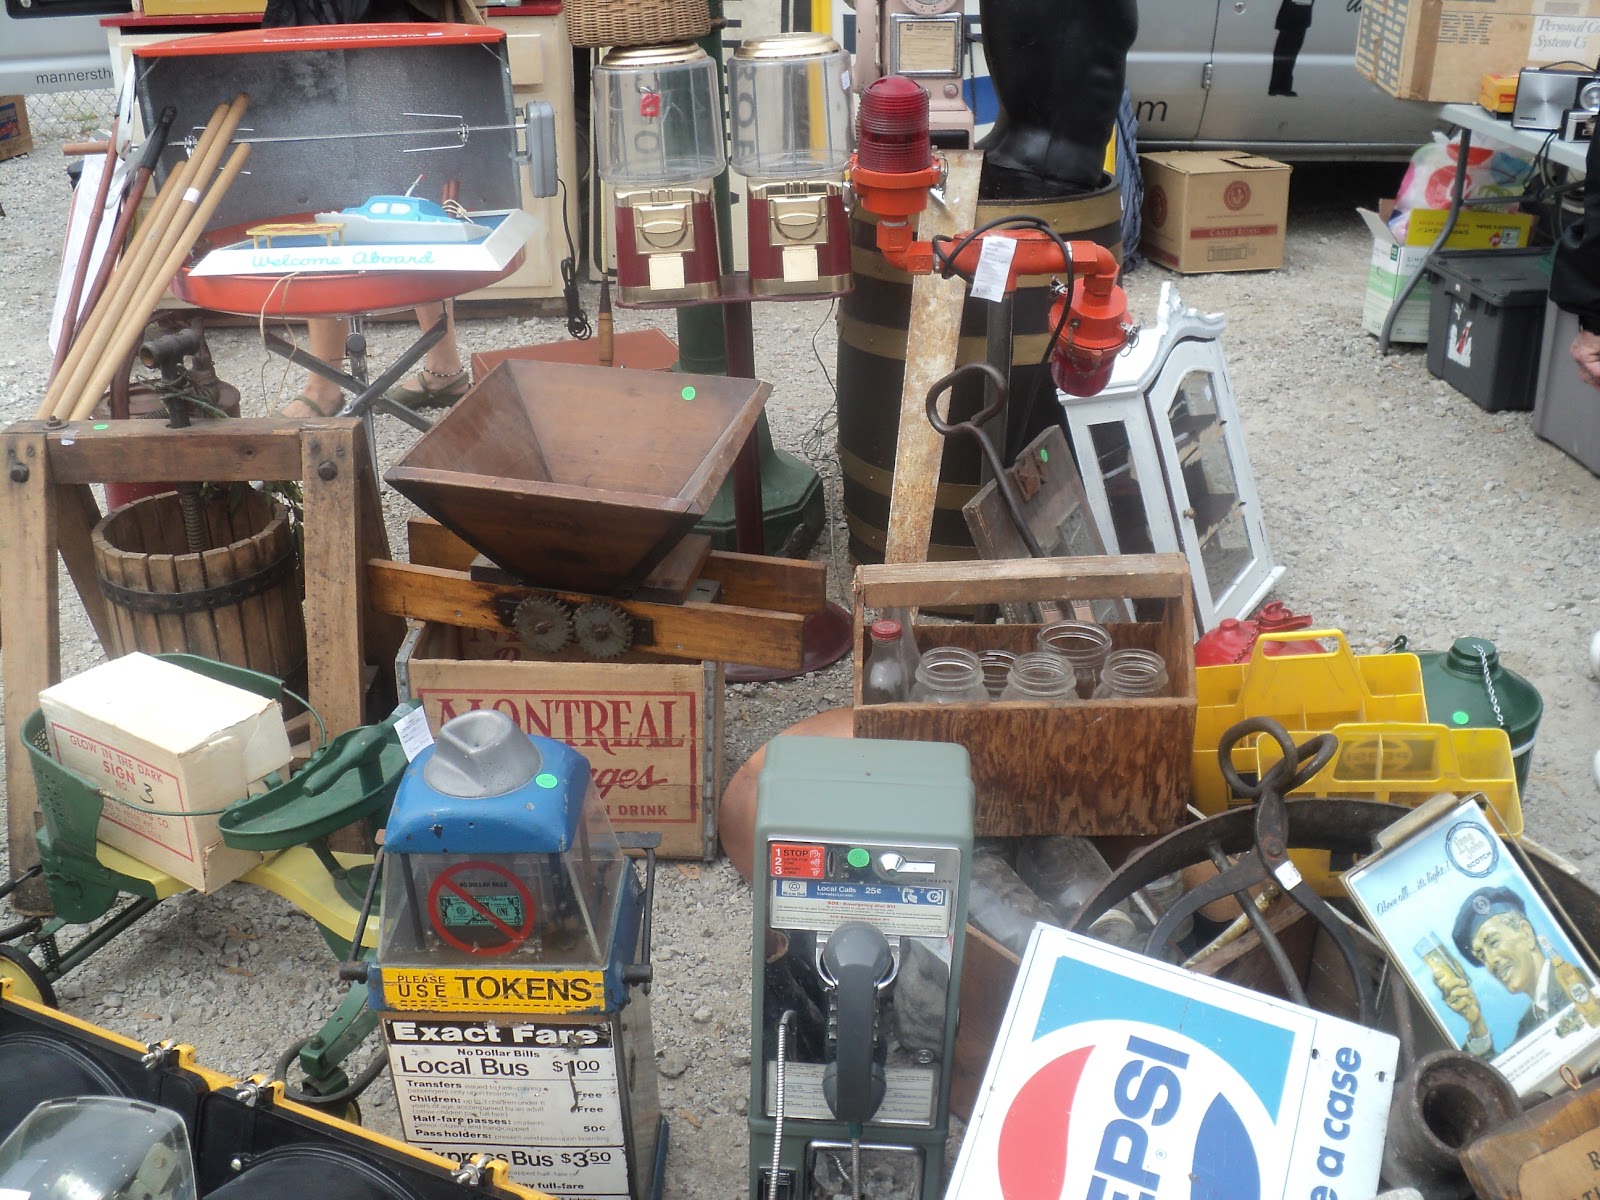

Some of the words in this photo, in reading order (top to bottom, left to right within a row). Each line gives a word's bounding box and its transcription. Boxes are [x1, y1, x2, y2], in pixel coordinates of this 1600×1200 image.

[1437, 14, 1493, 44] BM
[1538, 20, 1587, 32] Personal
[1535, 35, 1572, 51] System
[36, 67, 114, 84] mannersth
[252, 254, 343, 268] Welcome
[352, 251, 436, 264] Aboard
[70, 735, 97, 754] GLOW
[102, 748, 112, 760] IN
[116, 754, 133, 770] THE
[137, 764, 164, 784] DARK
[102, 760, 136, 785] SIGN
[591, 765, 668, 800] ges
[139, 782, 154, 804] 3
[618, 805, 668, 816] DRINK
[775, 848, 781, 856] 1
[1466, 851, 1492, 870] SCOTCH
[775, 866, 782, 874] 3
[399, 985, 446, 998] USE
[454, 976, 592, 1002] TOKENS
[392, 1022, 500, 1042] Exact
[513, 1024, 598, 1044] Fare
[476, 1049, 510, 1057] Dollar
[514, 1050, 540, 1058] Bills
[401, 1056, 471, 1074] Local
[481, 1058, 529, 1076] Bus
[406, 1080, 462, 1088] Transfers
[409, 1095, 461, 1103] Children:
[576, 1090, 602, 1098] Free
[1324, 1046, 1362, 1141] case
[511, 1150, 554, 1167] Bus
[1316, 1145, 1345, 1177] a
